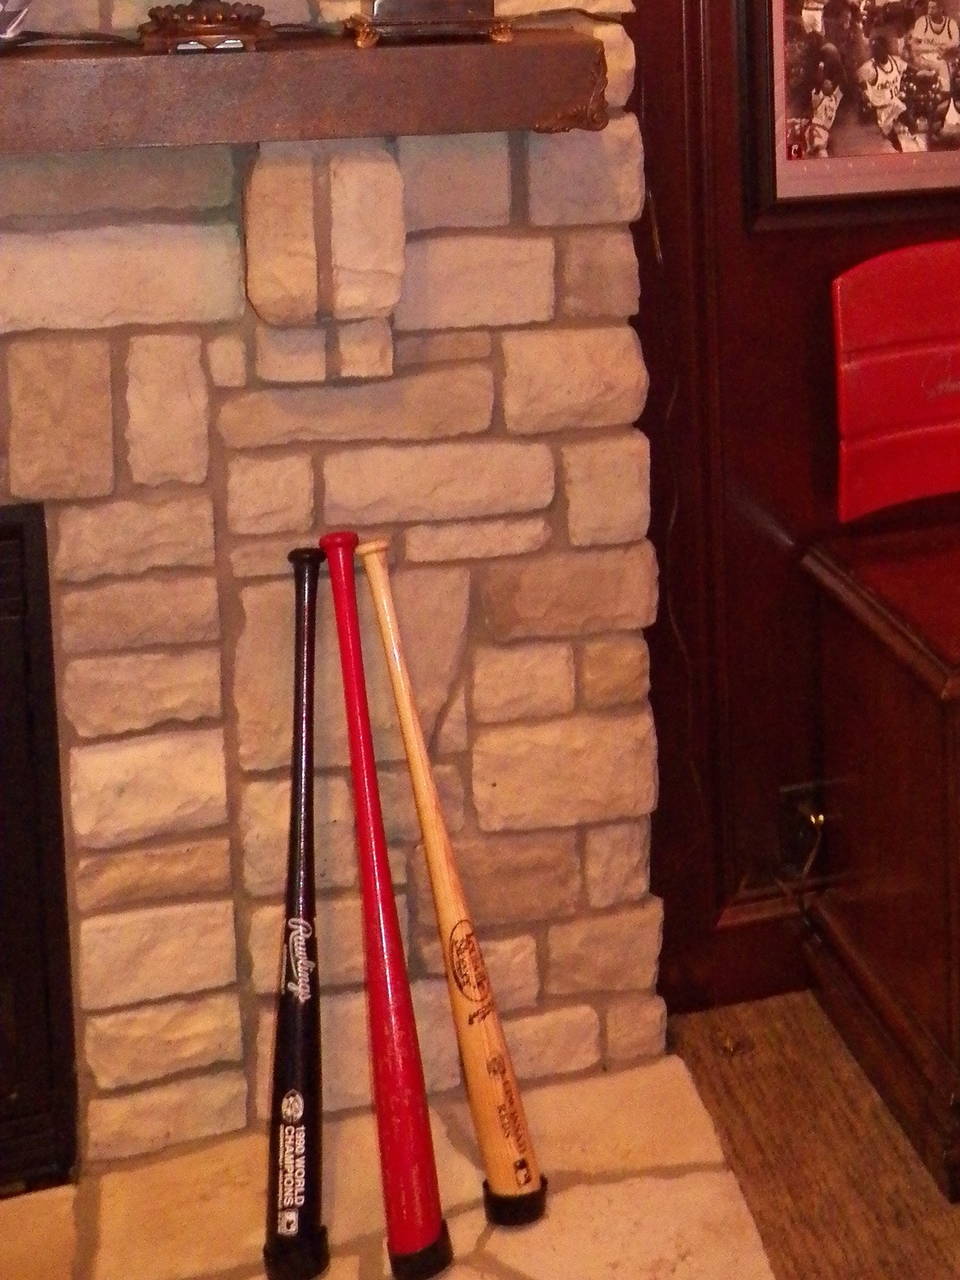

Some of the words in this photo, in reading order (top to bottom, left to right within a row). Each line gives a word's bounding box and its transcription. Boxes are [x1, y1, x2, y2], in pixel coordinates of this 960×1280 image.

[288, 917, 316, 1003] Rawlings
[282, 1125, 295, 1207] CHAMPIONS
[294, 1124, 306, 1156] 1990
[294, 1156, 306, 1206] WORLD
